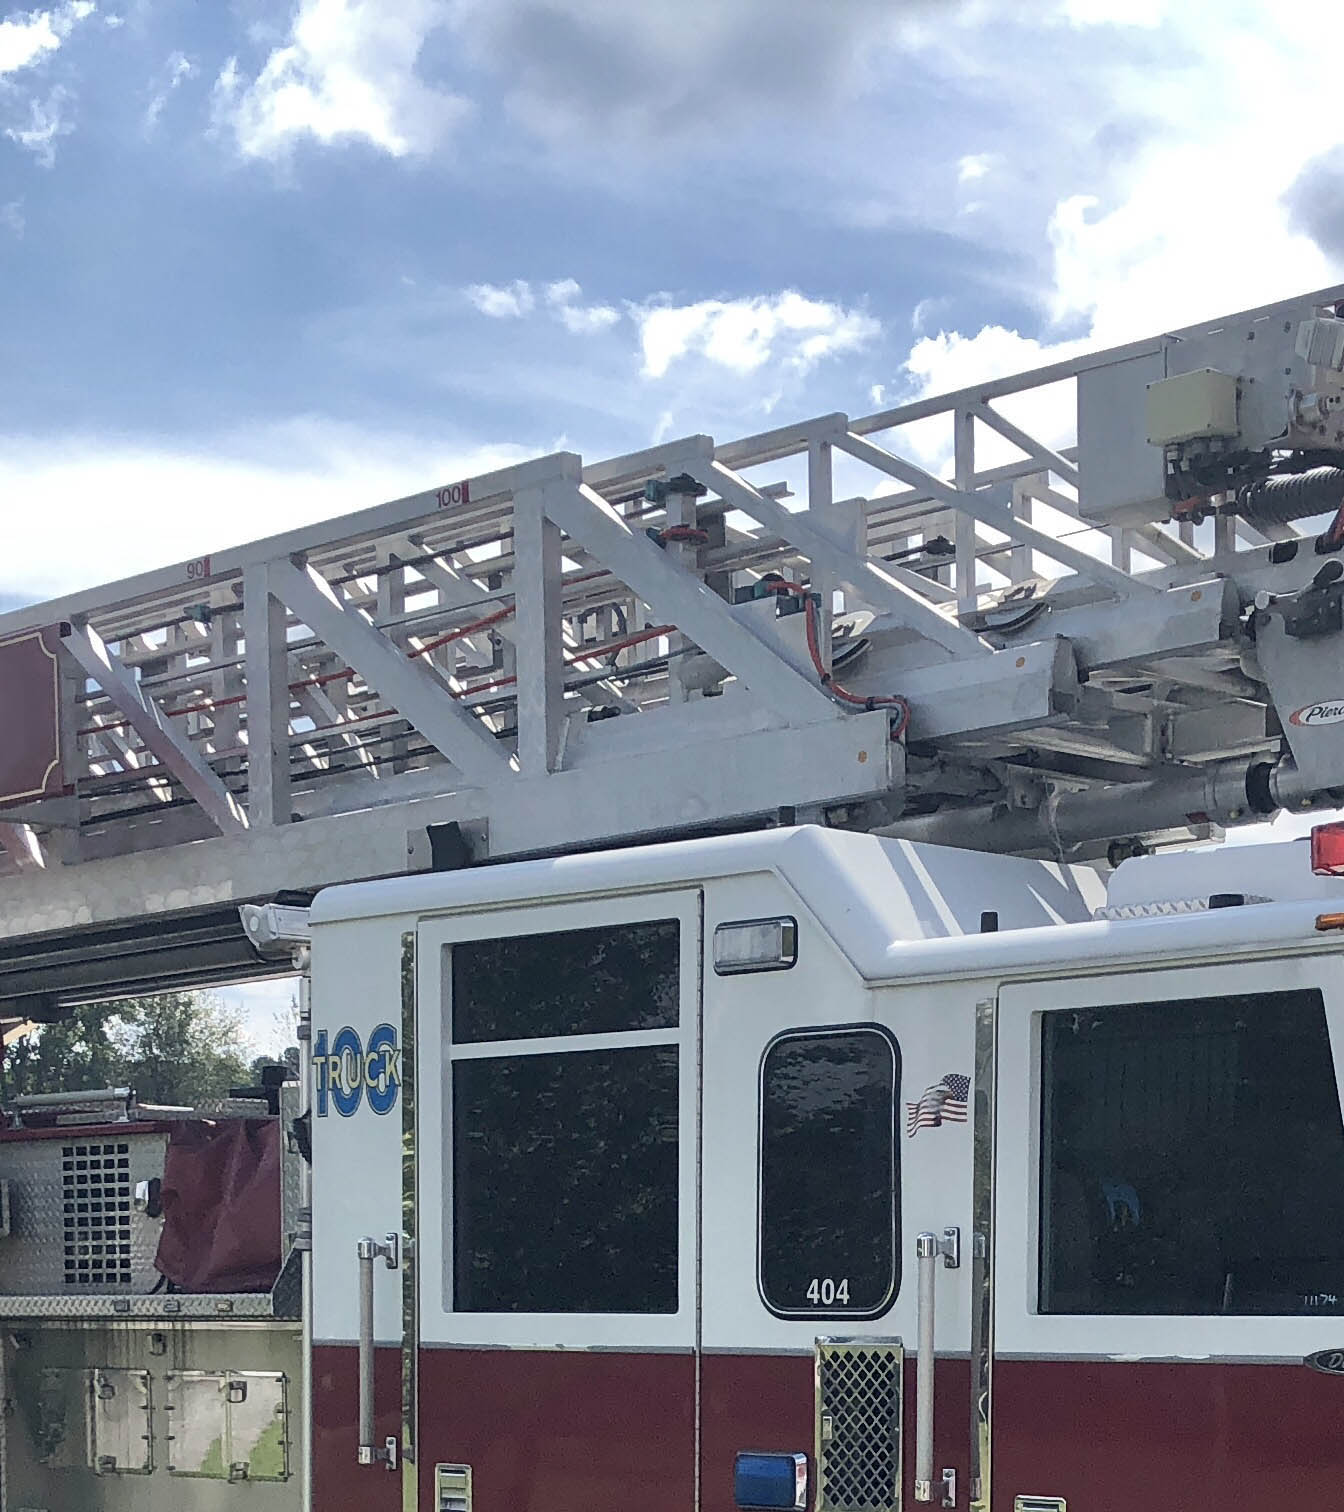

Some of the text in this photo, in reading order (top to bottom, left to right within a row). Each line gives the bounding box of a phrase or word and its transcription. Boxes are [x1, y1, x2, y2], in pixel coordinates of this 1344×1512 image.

[436, 485, 461, 508] 100
[186, 560, 203, 579] 90
[312, 1049, 402, 1091] TRUCK
[806, 1278, 850, 1305] 404
